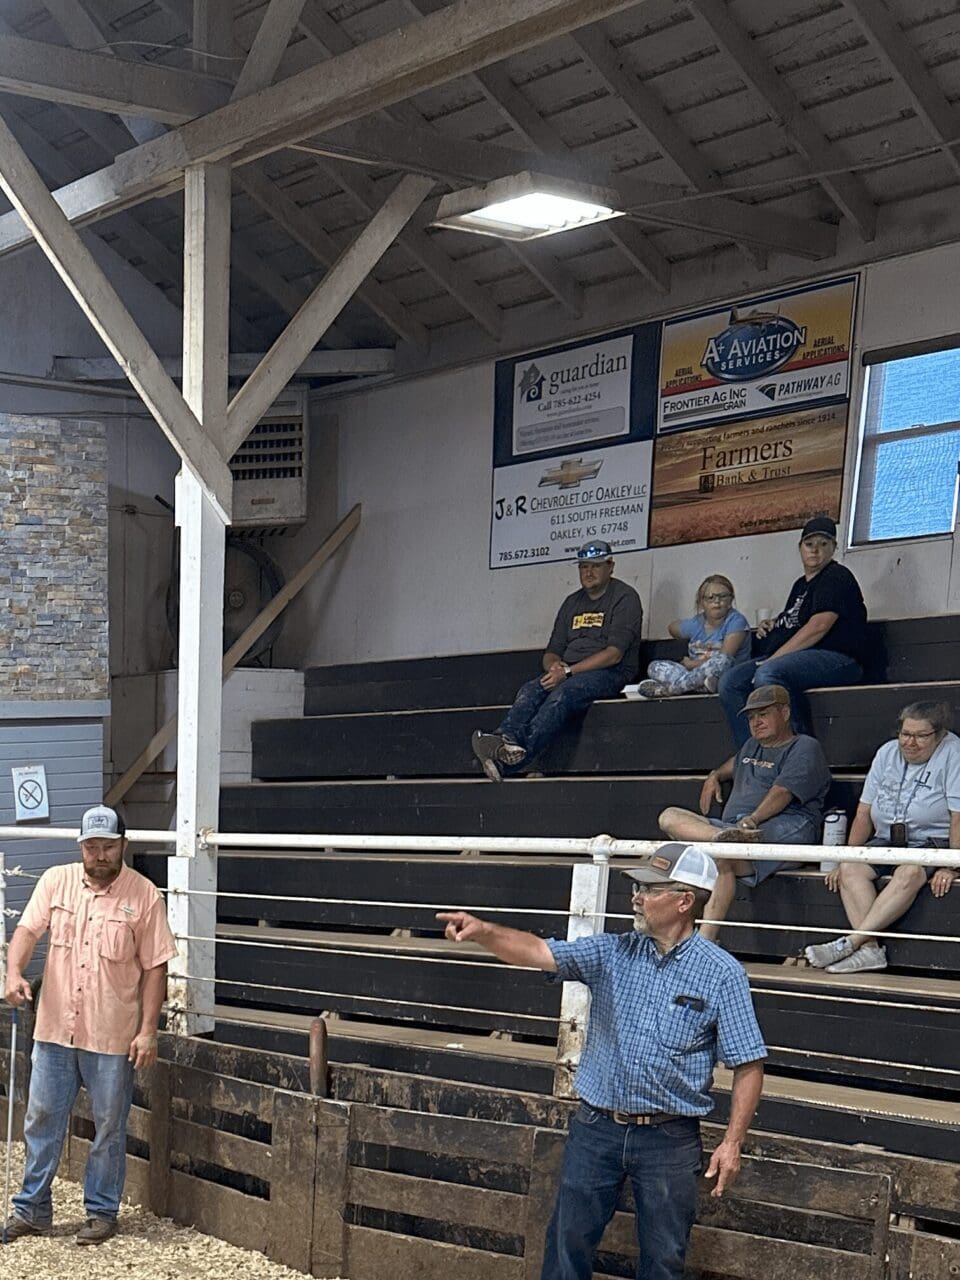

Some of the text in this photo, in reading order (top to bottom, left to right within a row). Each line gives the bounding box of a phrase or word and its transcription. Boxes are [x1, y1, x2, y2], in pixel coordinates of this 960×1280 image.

[727, 327, 806, 360] AVIATION
[813, 335, 835, 348] AERIAL
[721, 351, 780, 371] SERVICES
[548, 352, 628, 395] guardian
[778, 376, 827, 396] PATHWAY
[826, 372, 842, 387] AG
[663, 395, 710, 413] FRONTIER
[723, 399, 746, 411] GRAIN
[723, 429, 749, 440] farmers
[701, 439, 793, 471] Farmers
[716, 466, 791, 488] Bank & Trust
[530, 492, 580, 511] CHEVROLET
[581, 490, 594, 503] OF
[595, 485, 633, 501] OAKLEY
[550, 503, 644, 525] 611 SOUTH FREEMAN
[550, 521, 628, 542] OAKLEY, KS 67748
[499, 546, 550, 562] 785.672.3102
